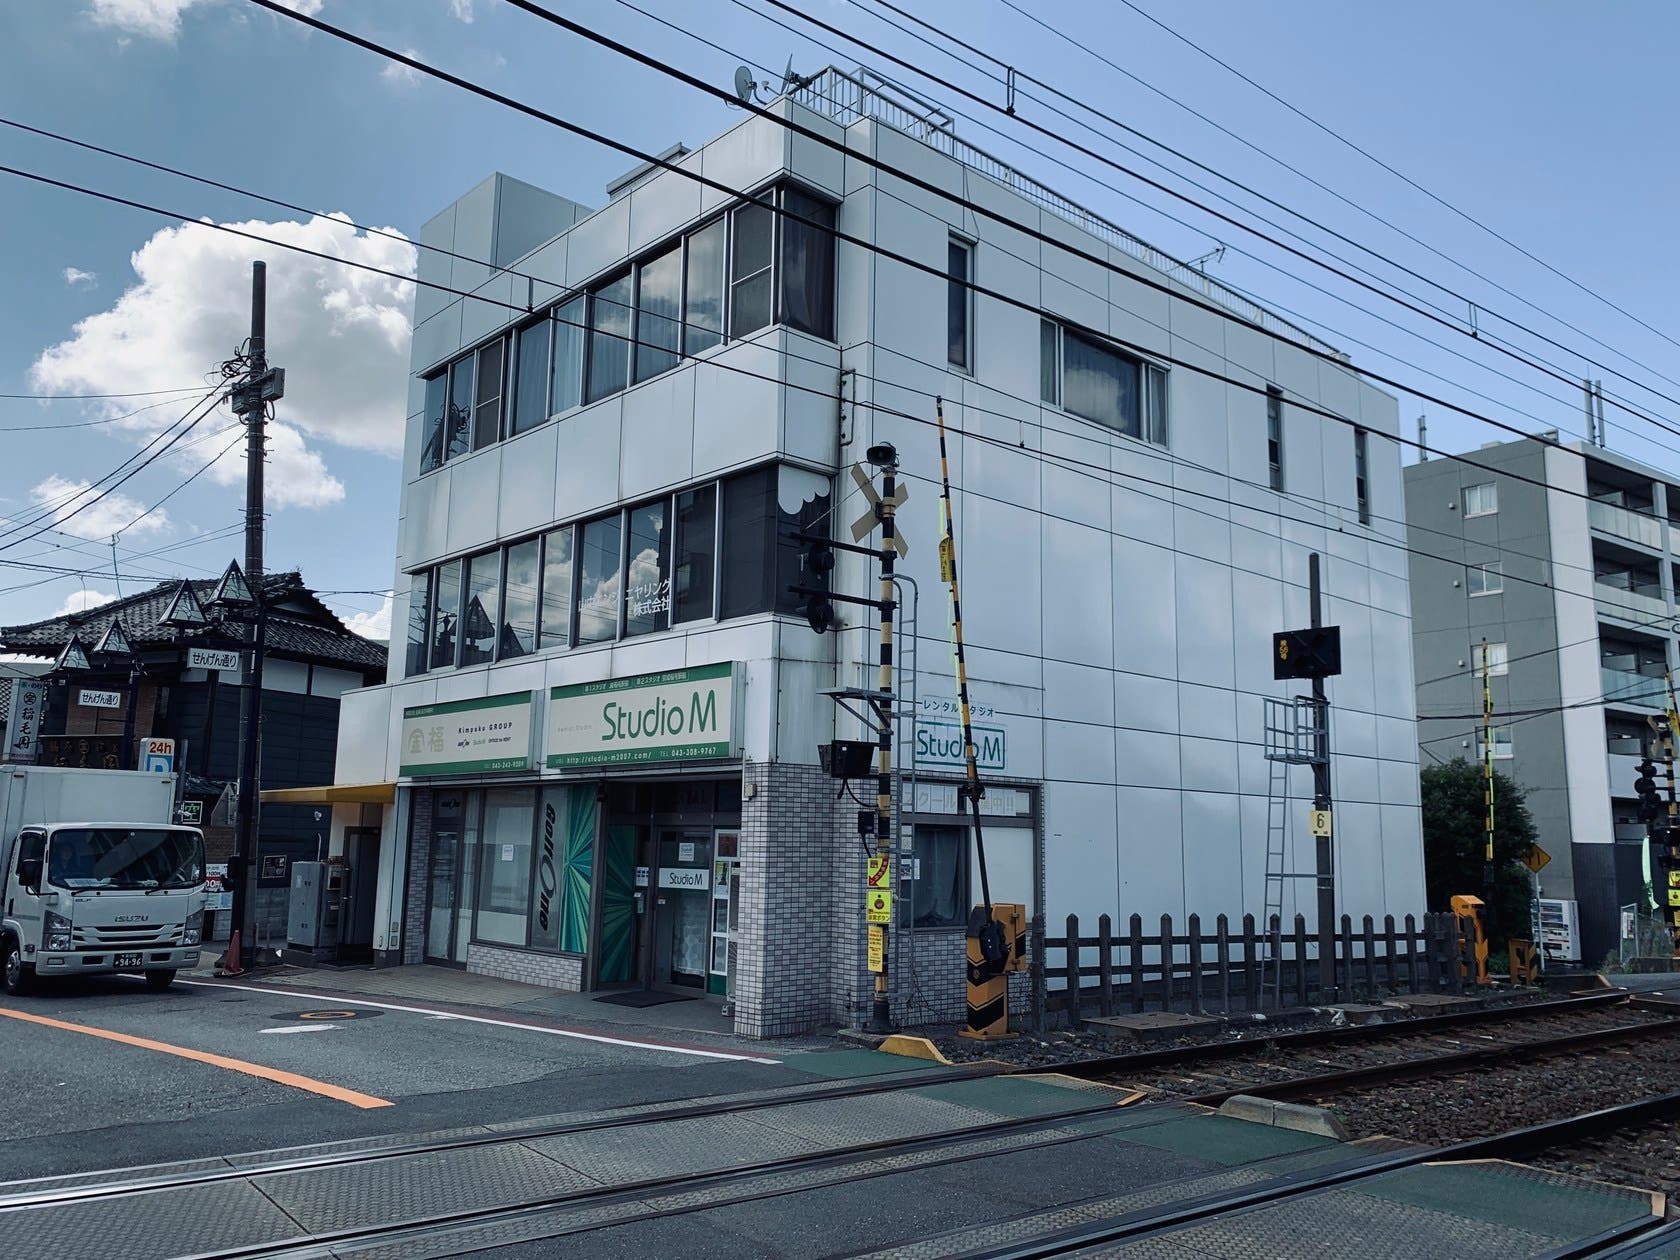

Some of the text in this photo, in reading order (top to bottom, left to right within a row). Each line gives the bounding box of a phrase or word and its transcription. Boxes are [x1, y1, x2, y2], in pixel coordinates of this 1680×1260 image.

[633, 595, 670, 616] 株式会社
[193, 652, 237, 668] せんげん通り
[82, 692, 119, 706] せんげん通り
[602, 689, 717, 741] Studio M
[923, 699, 995, 717] レンタルタジオ
[149, 741, 172, 754] 24h
[983, 736, 1001, 761] M
[1316, 813, 1325, 828] 6
[669, 872, 703, 886] Studio M
[115, 915, 149, 923] ISUZU
